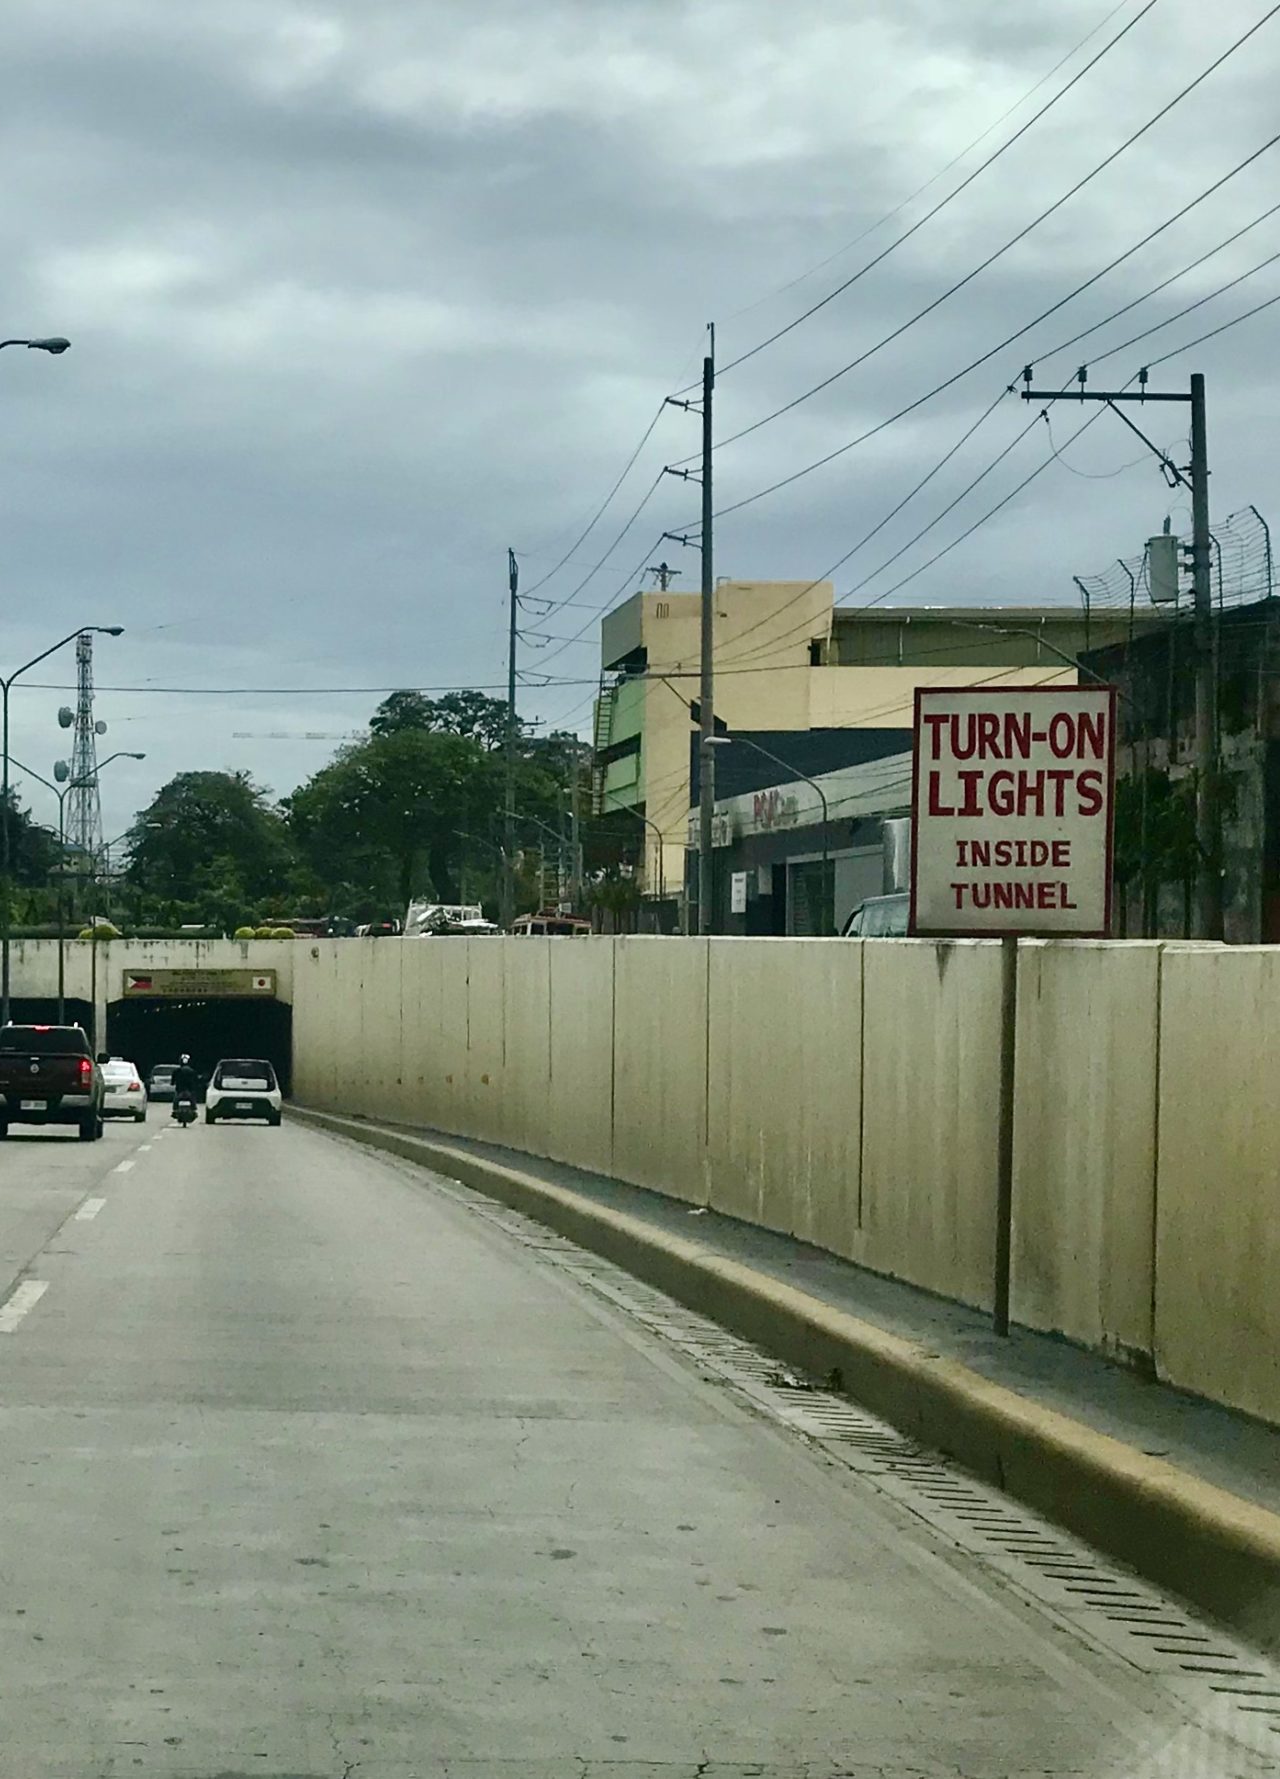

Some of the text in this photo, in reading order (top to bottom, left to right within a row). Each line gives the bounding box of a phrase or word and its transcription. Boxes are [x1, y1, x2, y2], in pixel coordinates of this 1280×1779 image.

[923, 712, 1105, 760] TURN-ON
[928, 769, 1103, 817] LIGHTS
[956, 840, 1071, 867] INSIDE
[950, 881, 1077, 909] TUNNEL
